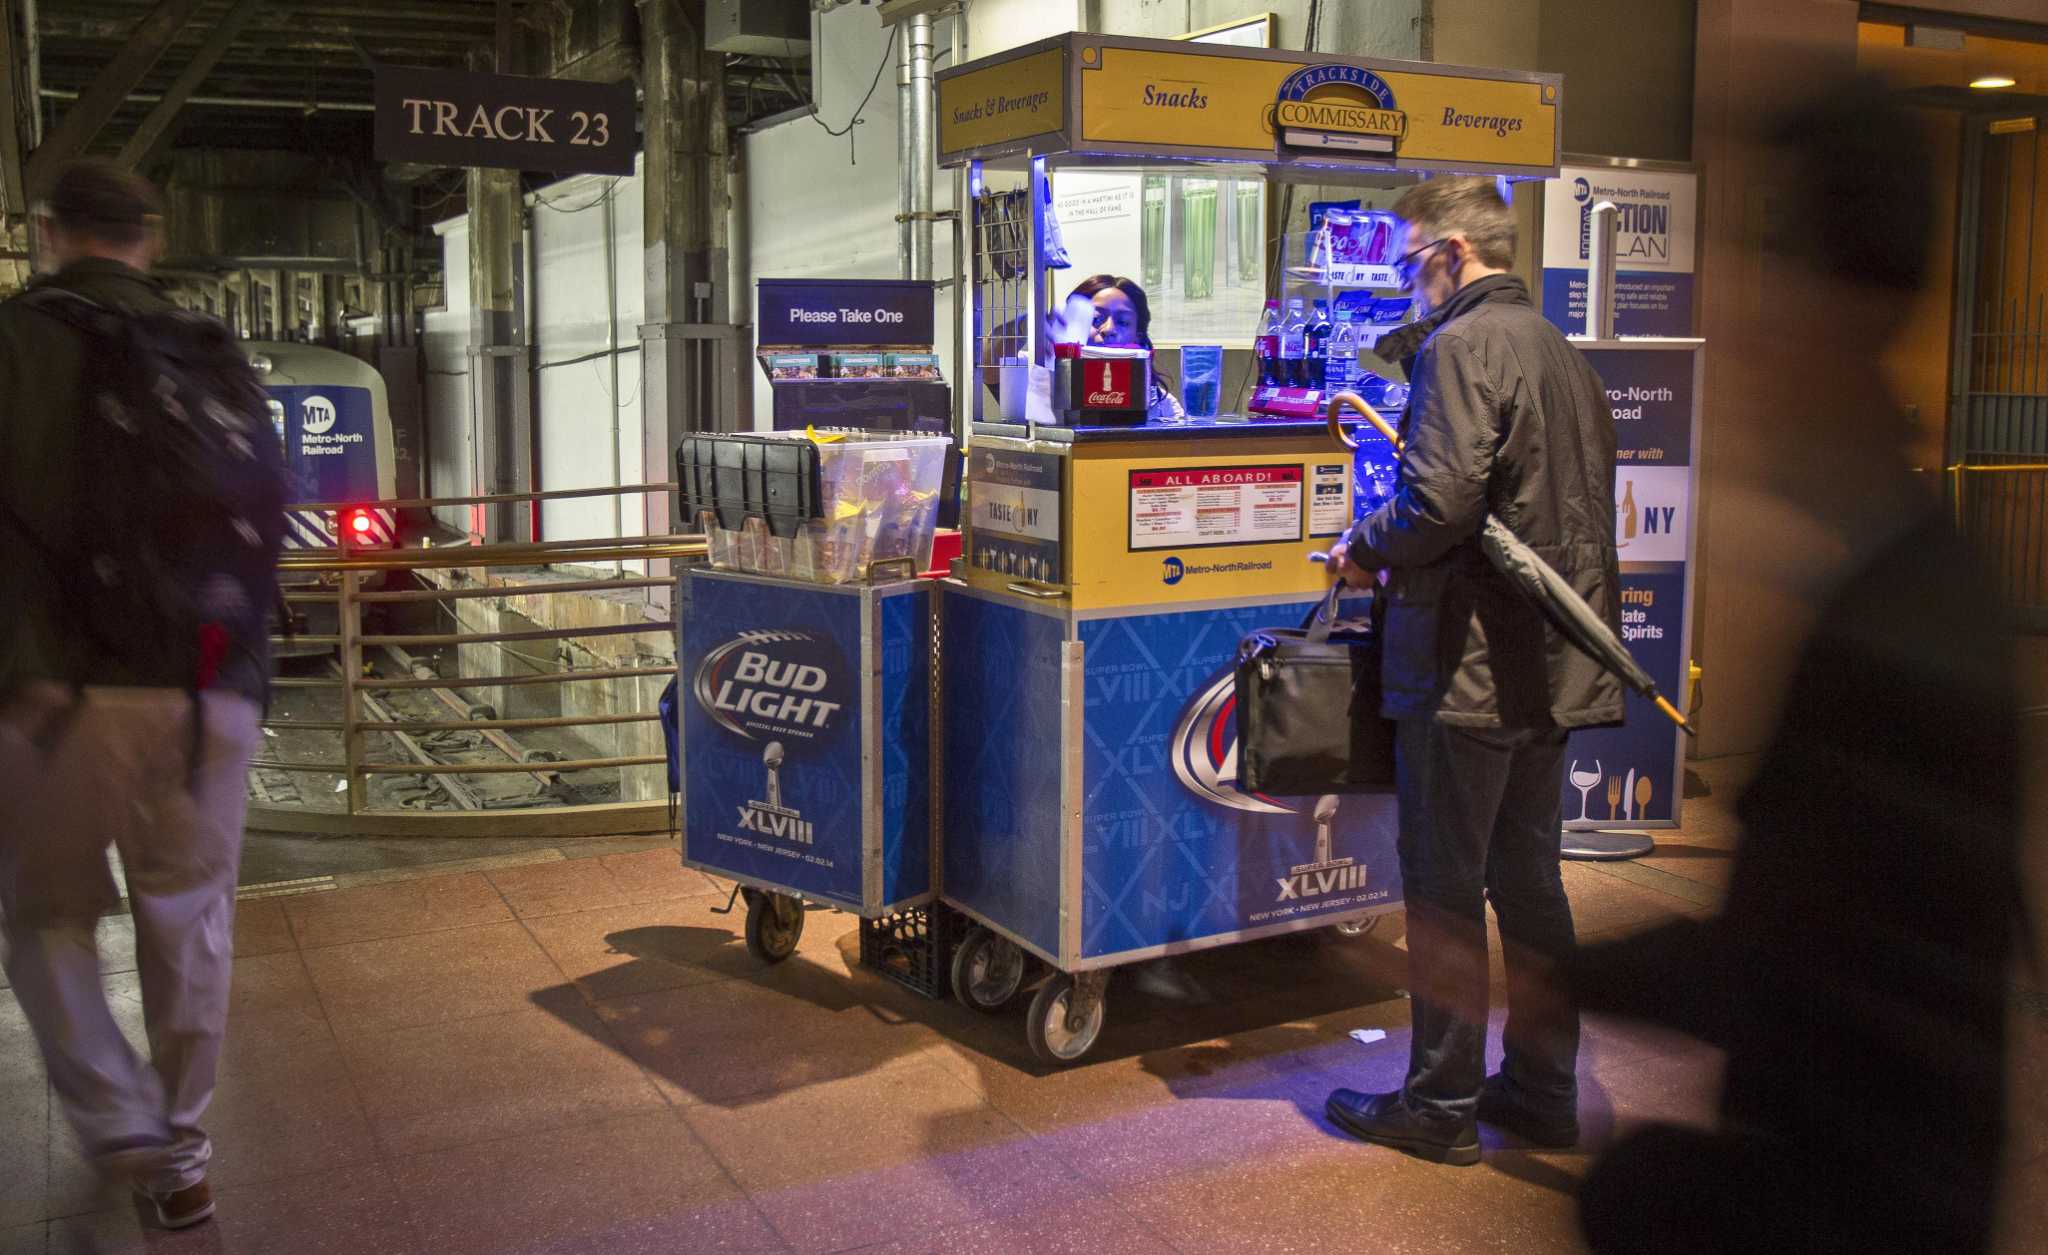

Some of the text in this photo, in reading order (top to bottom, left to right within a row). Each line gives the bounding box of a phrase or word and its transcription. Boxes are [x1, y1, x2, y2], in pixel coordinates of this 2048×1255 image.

[1142, 84, 1209, 110] Snacks
[1295, 67, 1388, 101] TRACKSIDE
[953, 90, 1049, 125] Snacks & Beverages
[1281, 103, 1401, 132] COMMISSARY
[402, 98, 610, 147] TRACK 23
[1441, 106, 1523, 138] Beverages
[1592, 186, 1639, 199] Metro-North
[1616, 203, 1667, 235] CTION
[1332, 272, 1345, 280] ASTE
[1371, 273, 1388, 281] TASTE
[790, 308, 904, 323] Please Take One
[1088, 391, 1127, 404] Coca-Cola
[302, 405, 331, 425] MTA
[302, 433, 364, 444] Metro-North
[302, 445, 343, 456] Railroad
[1638, 447, 1664, 460] with
[1165, 472, 1273, 485] ALL ABOARD!
[989, 502, 1039, 526] TASTE NY
[1644, 506, 1675, 534] NY
[1185, 560, 1237, 575] Metro-North
[1237, 560, 1272, 573] Railroad
[1621, 624, 1664, 641] Spirits
[734, 651, 828, 693] BUD
[714, 680, 841, 728] LIGHT
[772, 725, 787, 734] BEER
[736, 805, 814, 845] XLVIII
[735, 836, 753, 847] YORK
[757, 842, 774, 853] NEW
[775, 846, 801, 859] JERSEY
[805, 854, 834, 869] 02.02.14
[1275, 864, 1367, 902] XLVIII
[1249, 889, 1389, 921] NEW YORK NEW JERSEY 02.02.14
